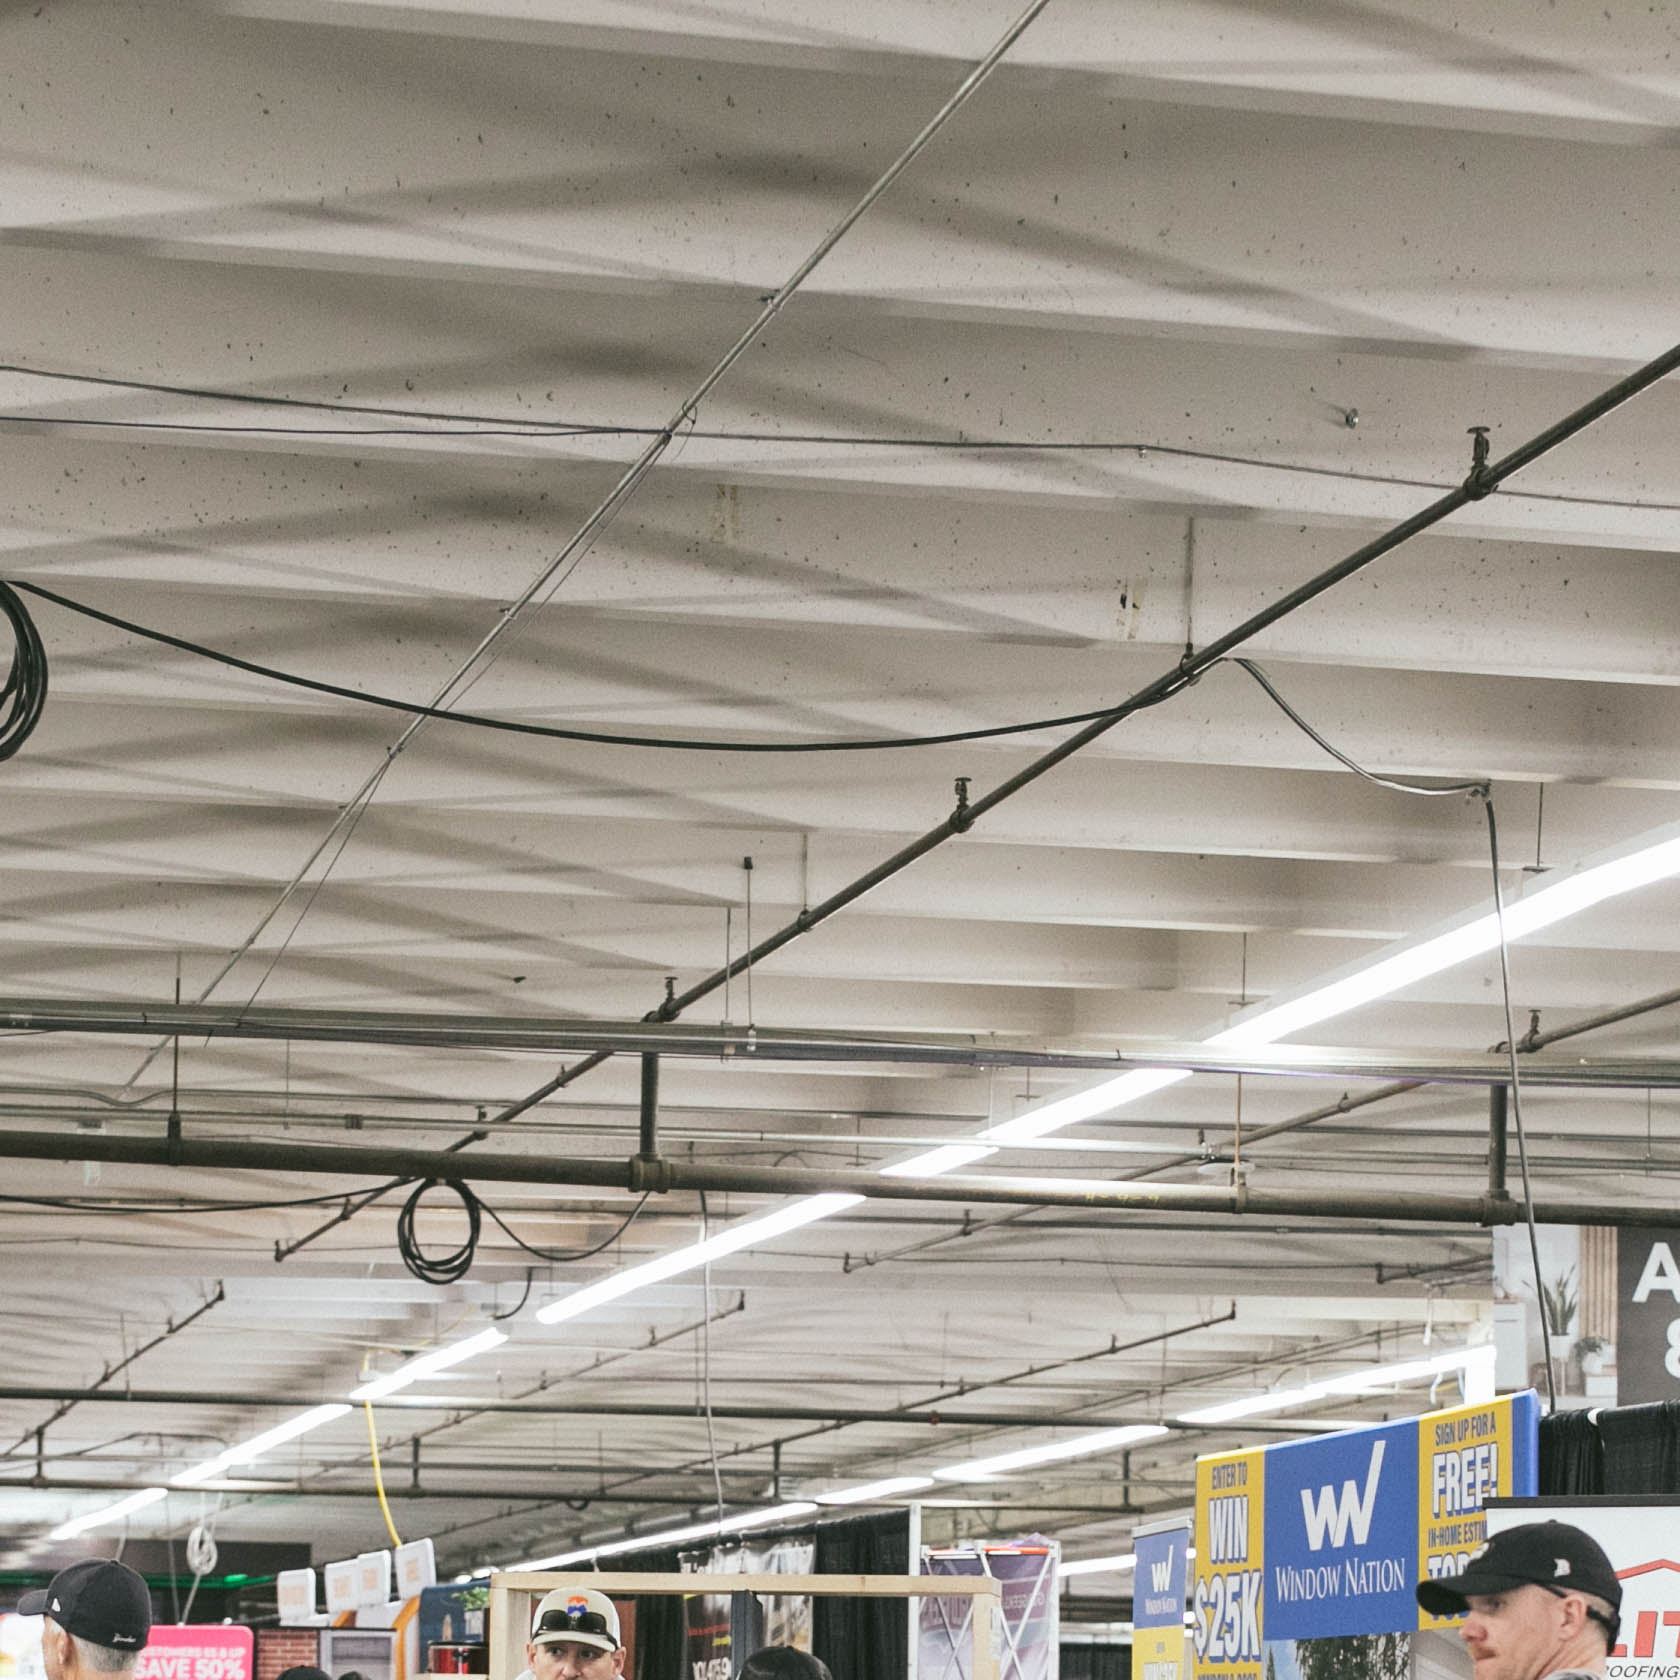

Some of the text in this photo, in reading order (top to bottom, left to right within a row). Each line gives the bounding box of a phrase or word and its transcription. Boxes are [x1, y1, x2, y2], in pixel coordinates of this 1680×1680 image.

[1435, 1410, 1496, 1447] SIGN UP FOR A
[1212, 1461, 1249, 1490] ENTER TO
[1432, 1442, 1498, 1519] FREE!
[1208, 1494, 1249, 1565] WIN
[1428, 1524, 1461, 1549] IN-HOME
[1275, 1557, 1406, 1603] WINDOW NATION
[1194, 1569, 1263, 1665] $25K
[135, 1657, 246, 1680] SAVE 50%
